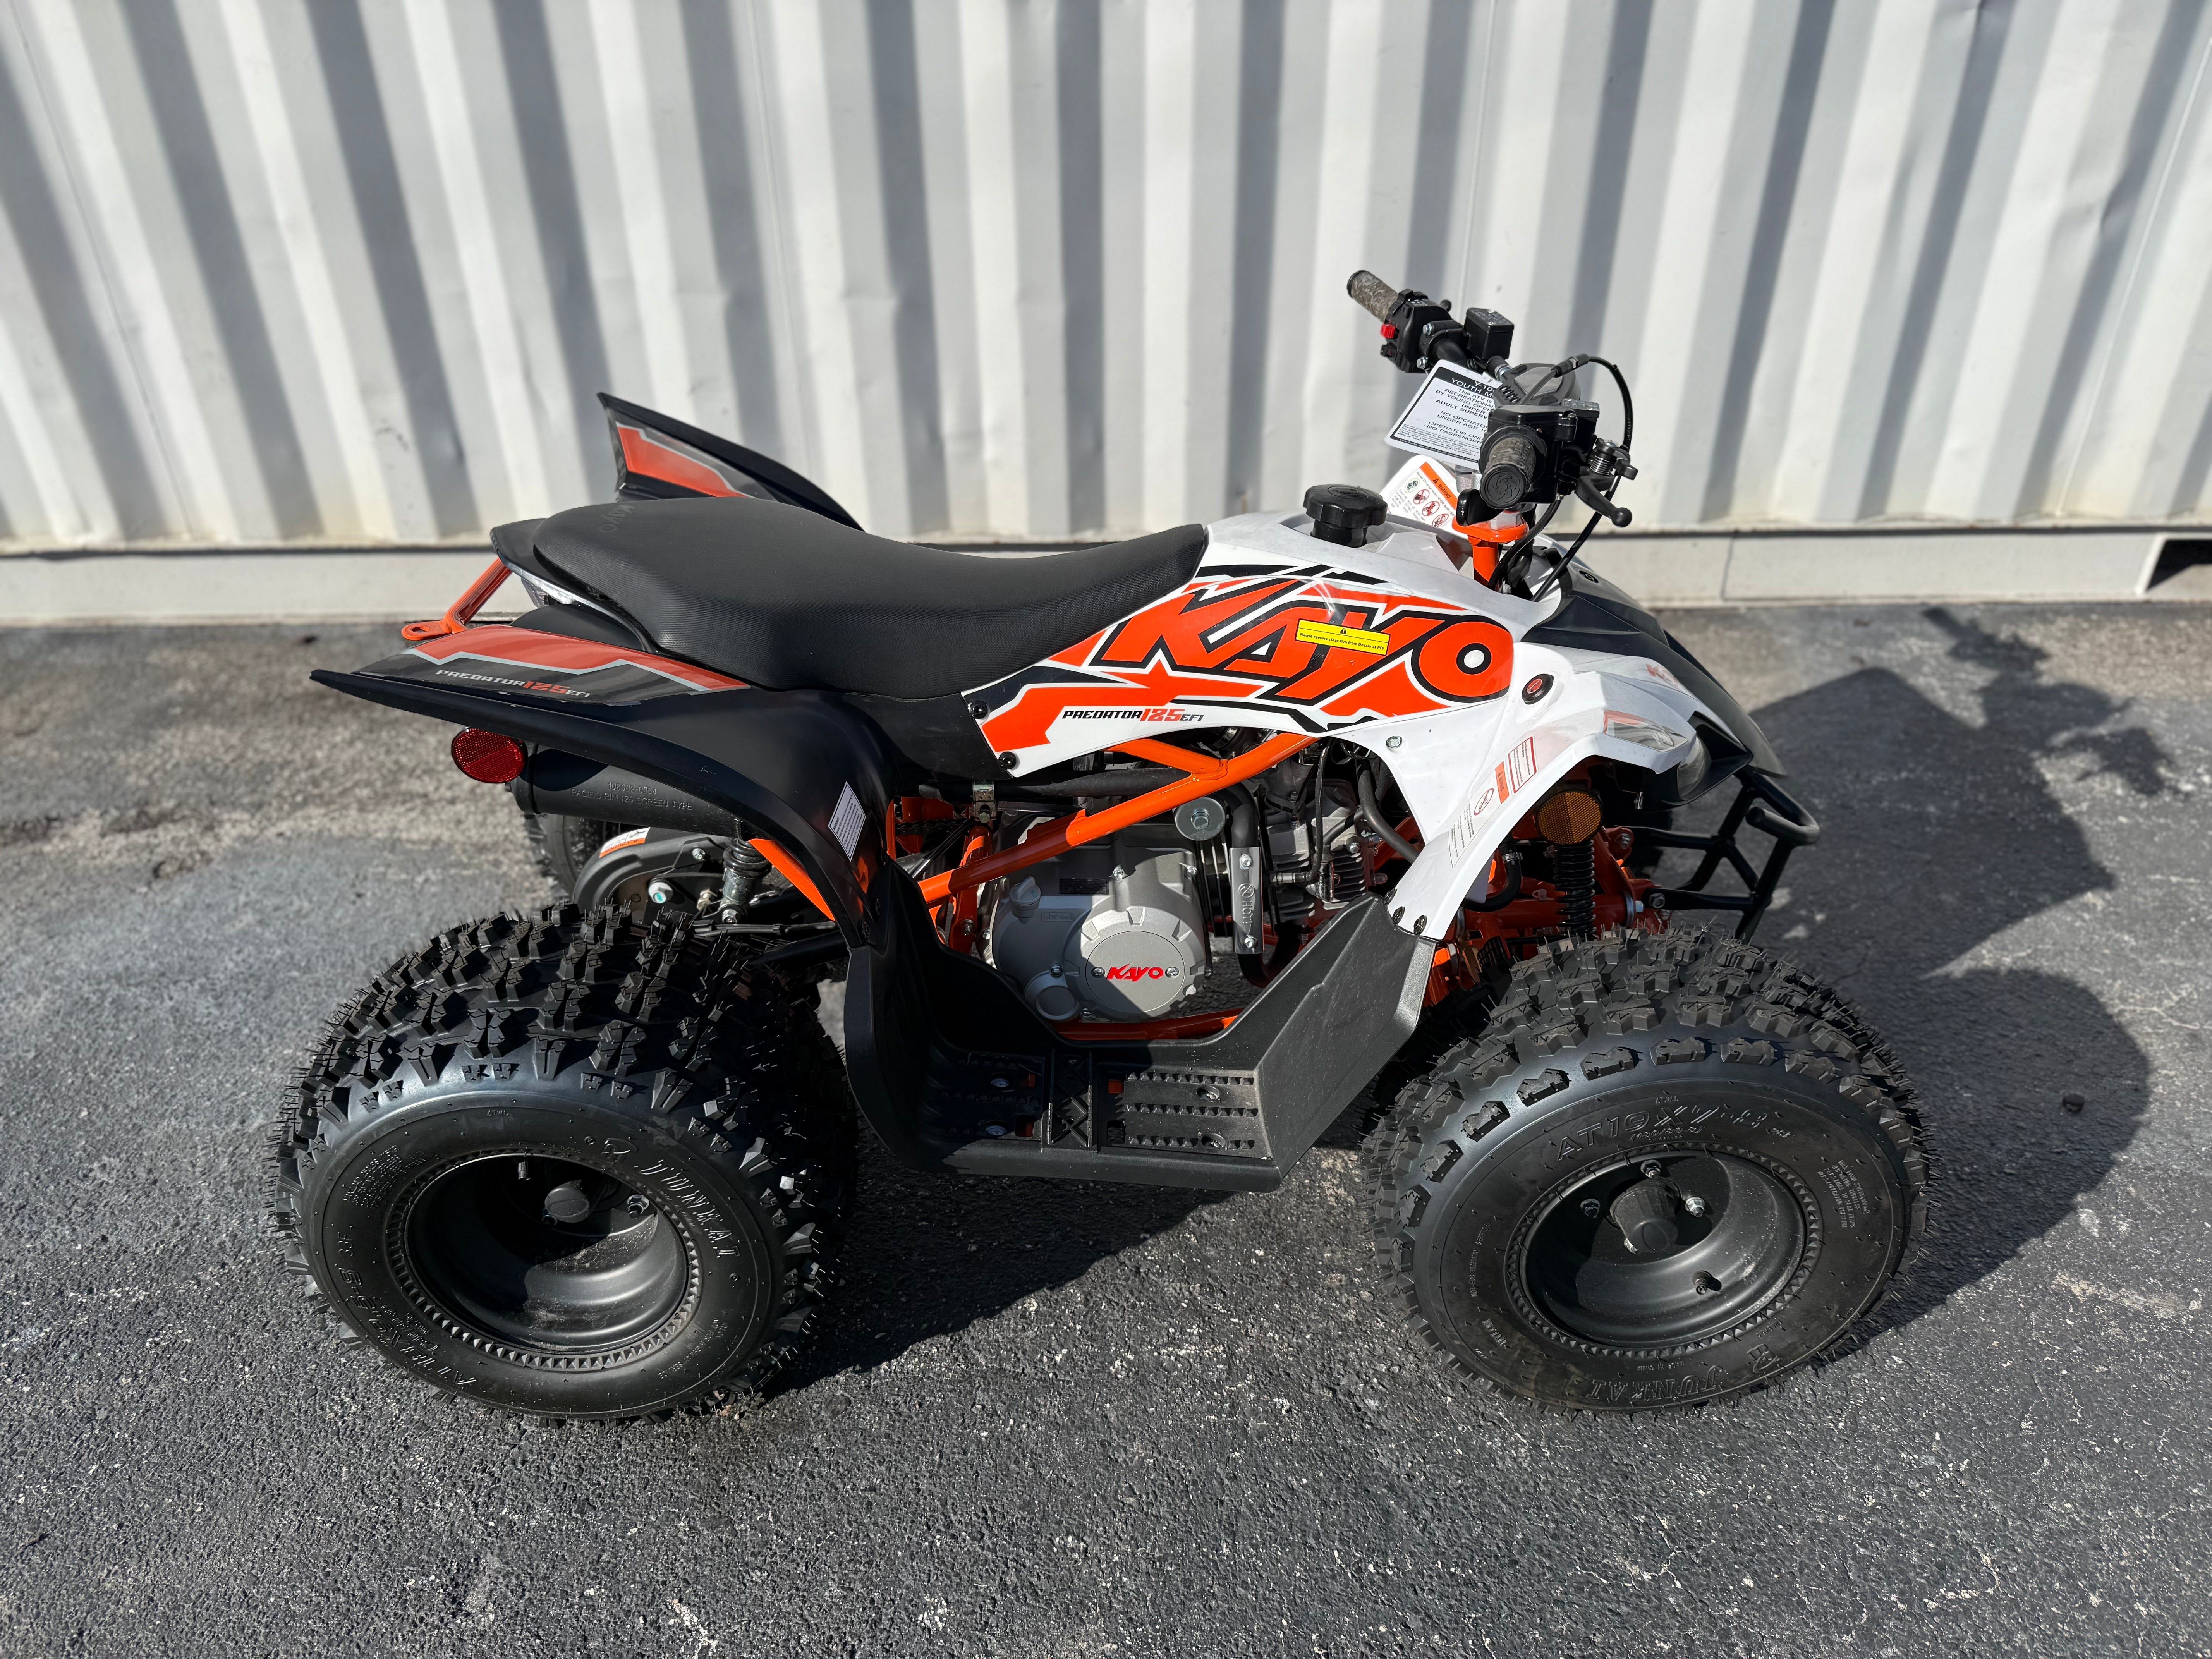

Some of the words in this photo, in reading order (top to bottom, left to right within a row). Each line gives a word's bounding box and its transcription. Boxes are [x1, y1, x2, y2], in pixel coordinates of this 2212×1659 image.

[1452, 378, 1482, 393] YOUTH
[1474, 381, 1494, 392] Y-10
[1436, 399, 1458, 409] ADULT
[1447, 393, 1470, 405] YOUNG
[1462, 404, 1486, 414] UNDER
[1437, 414, 1461, 424] UNDER
[1429, 421, 1466, 436] OPERATOR
[1437, 483, 1451, 499] WARNING
[1089, 578, 1512, 702] KAYO
[571, 788, 601, 799] PACIFIC
[604, 793, 618, 801] RIM
[672, 801, 693, 811] TYPE
[1106, 962, 1164, 982] KAYO
